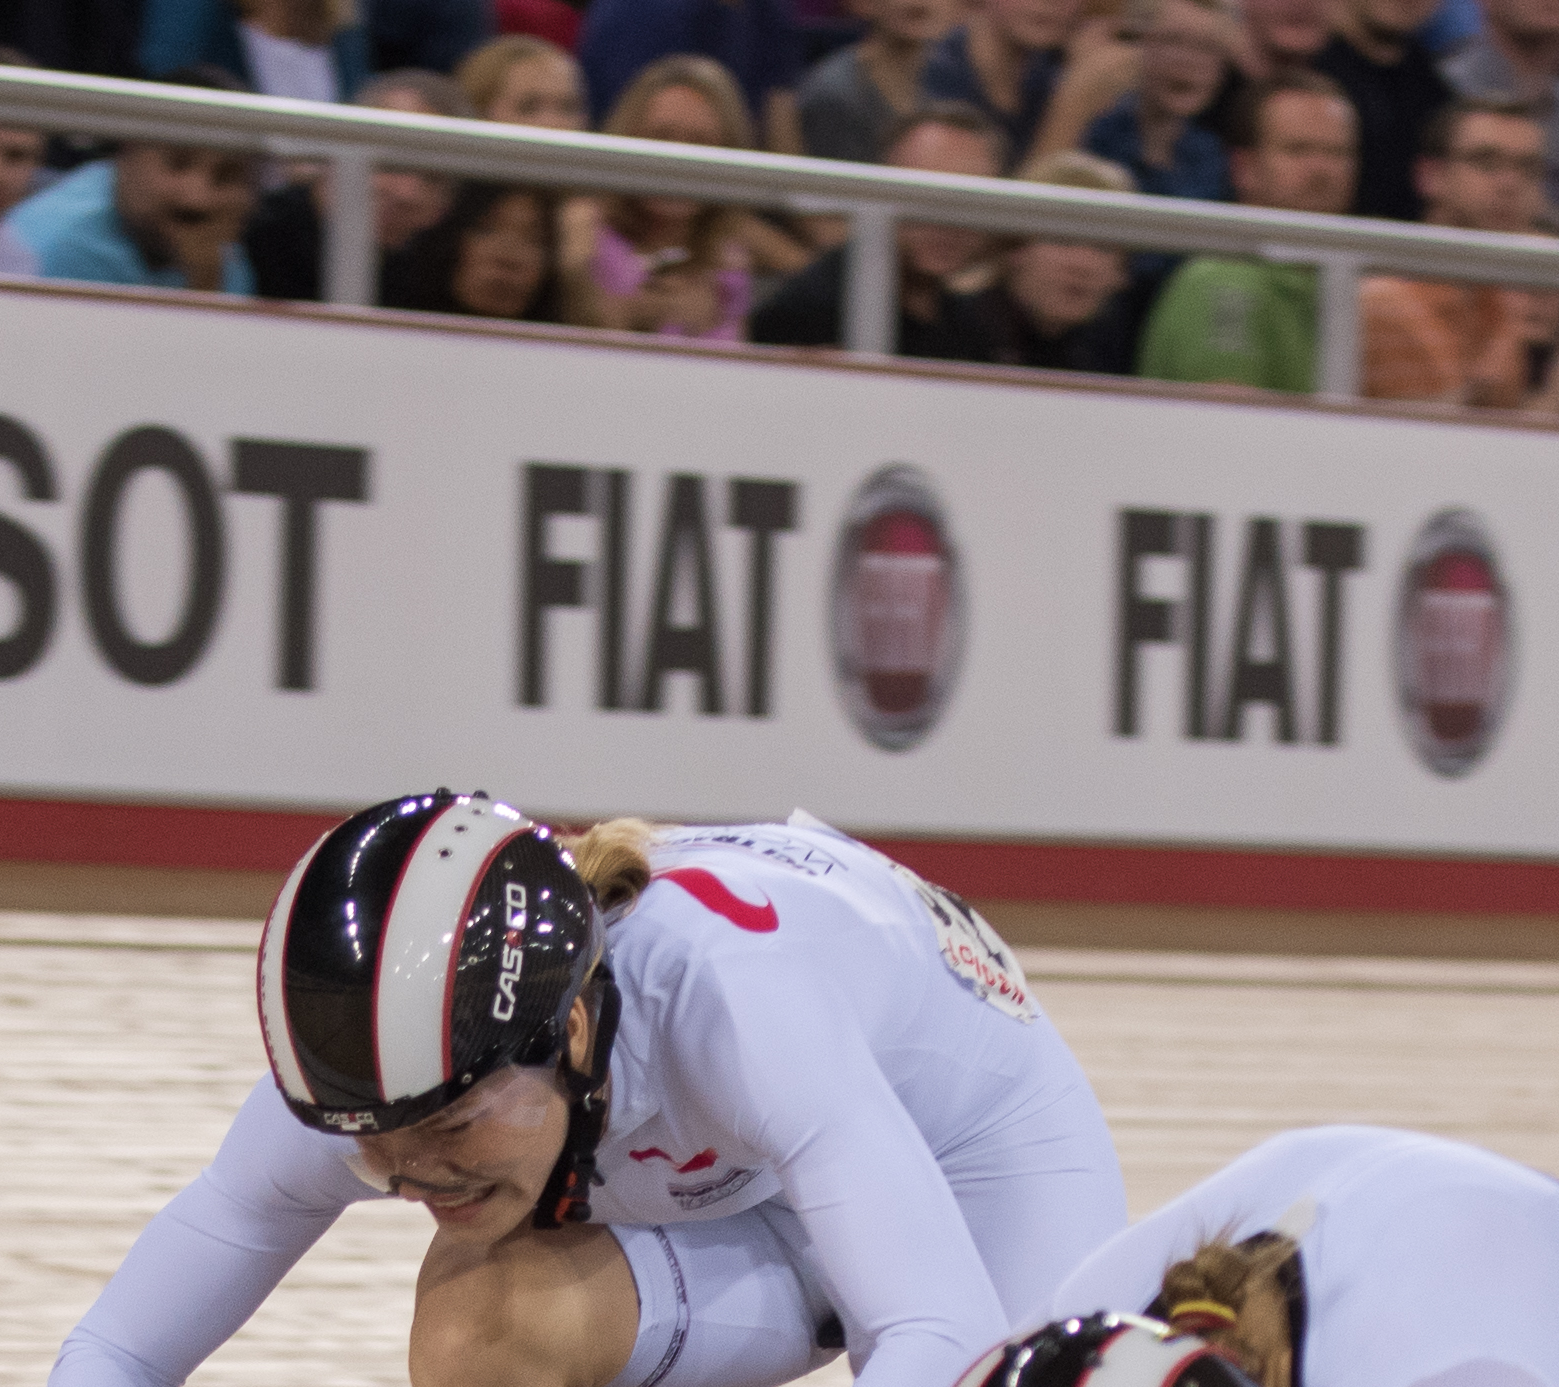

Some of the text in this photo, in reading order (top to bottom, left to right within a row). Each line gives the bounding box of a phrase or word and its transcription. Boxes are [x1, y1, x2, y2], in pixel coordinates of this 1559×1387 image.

[516, 461, 802, 719] FIAT
[1113, 508, 1366, 745] FIAT
[492, 882, 527, 1022] CASCO
